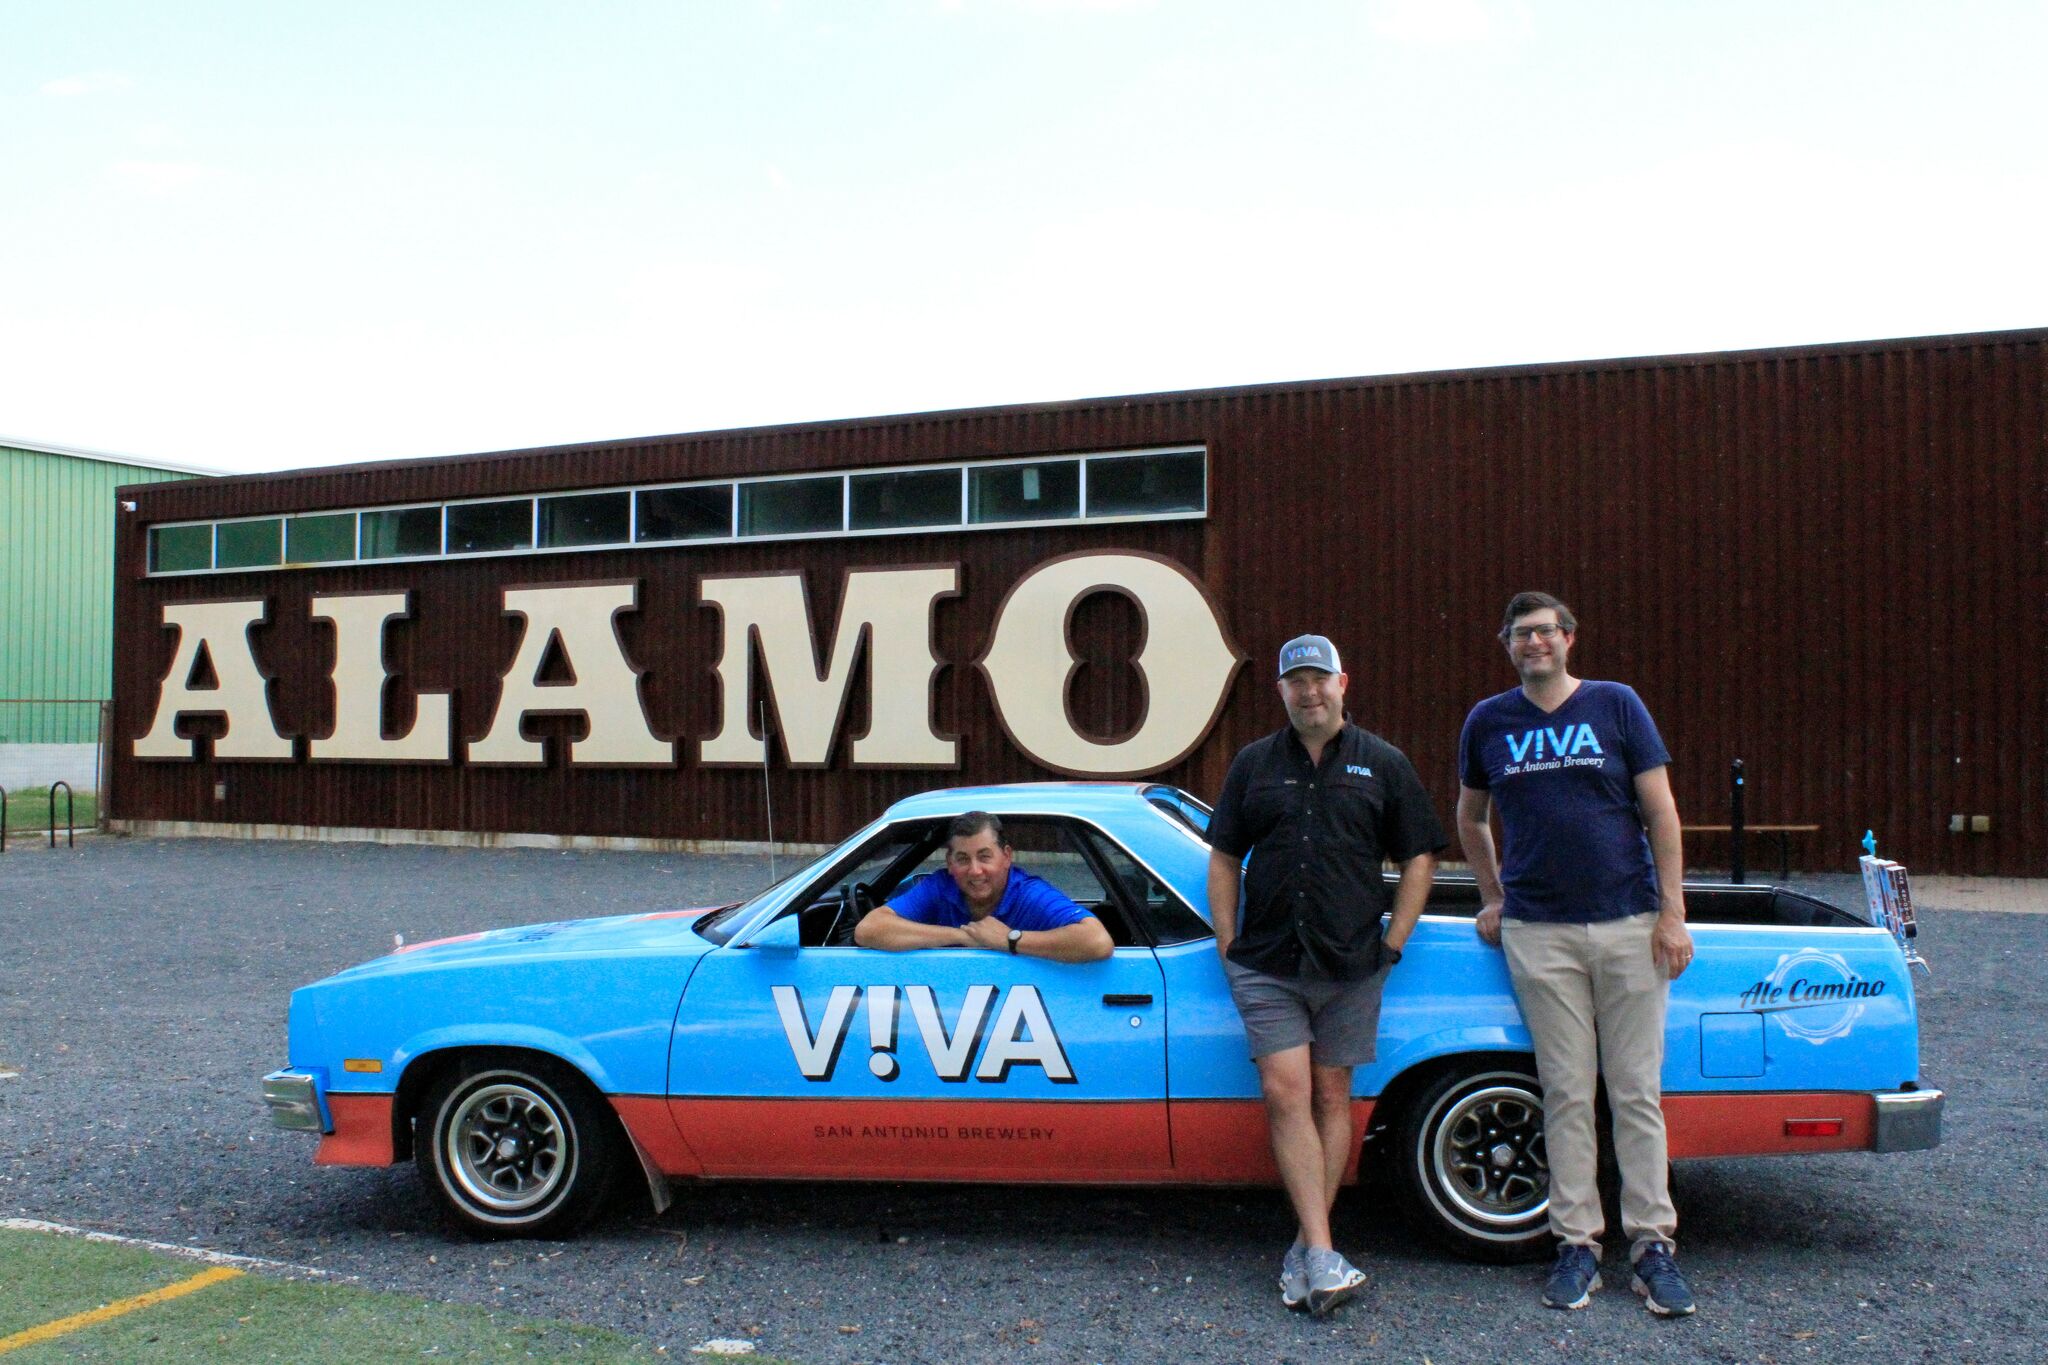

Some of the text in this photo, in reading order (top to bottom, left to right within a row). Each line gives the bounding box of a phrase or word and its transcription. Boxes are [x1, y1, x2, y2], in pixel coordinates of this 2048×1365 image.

[132, 553, 1240, 774] ALAMO
[1505, 723, 1604, 763] V!VA
[1503, 755, 1606, 776] San Antonio Brewery
[1740, 976, 1886, 1009] Ale Camino
[770, 984, 1079, 1084] V!VA
[813, 1126, 1055, 1140] SAN ANTONIO BREWERY
